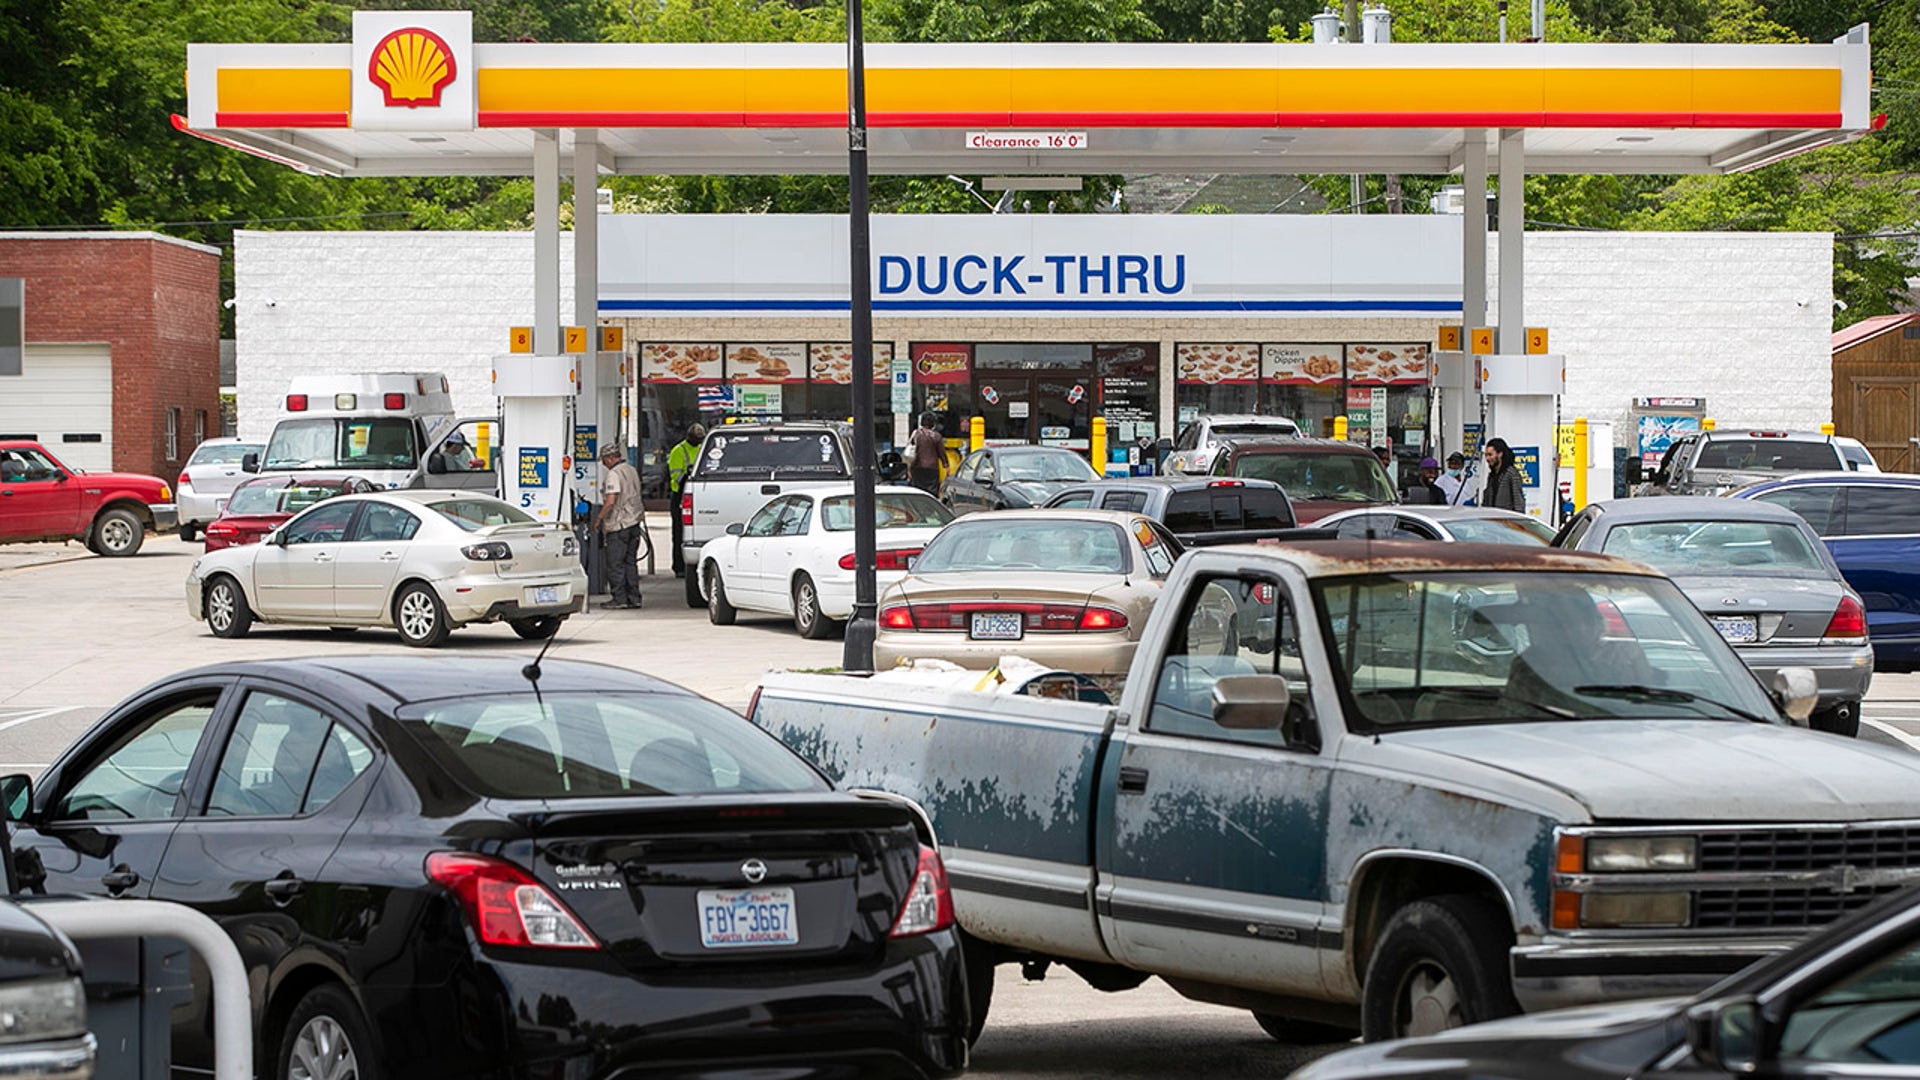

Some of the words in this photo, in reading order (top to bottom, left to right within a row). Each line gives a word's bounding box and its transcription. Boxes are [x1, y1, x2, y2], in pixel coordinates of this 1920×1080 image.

[972, 135, 1040, 147] Clearance
[878, 254, 1186, 295] DUCK-THRU
[518, 335, 526, 344] 8
[570, 334, 578, 343] 7
[608, 334, 615, 343] 5
[1447, 333, 1455, 343] 2
[1481, 336, 1489, 346] 4
[1533, 336, 1542, 347] 3
[1274, 356, 1305, 364] Dippers
[521, 470, 539, 478] FULL
[521, 477, 542, 485] PRICE
[1716, 622, 1753, 636] P-5408
[705, 903, 789, 933] FBY-3667
